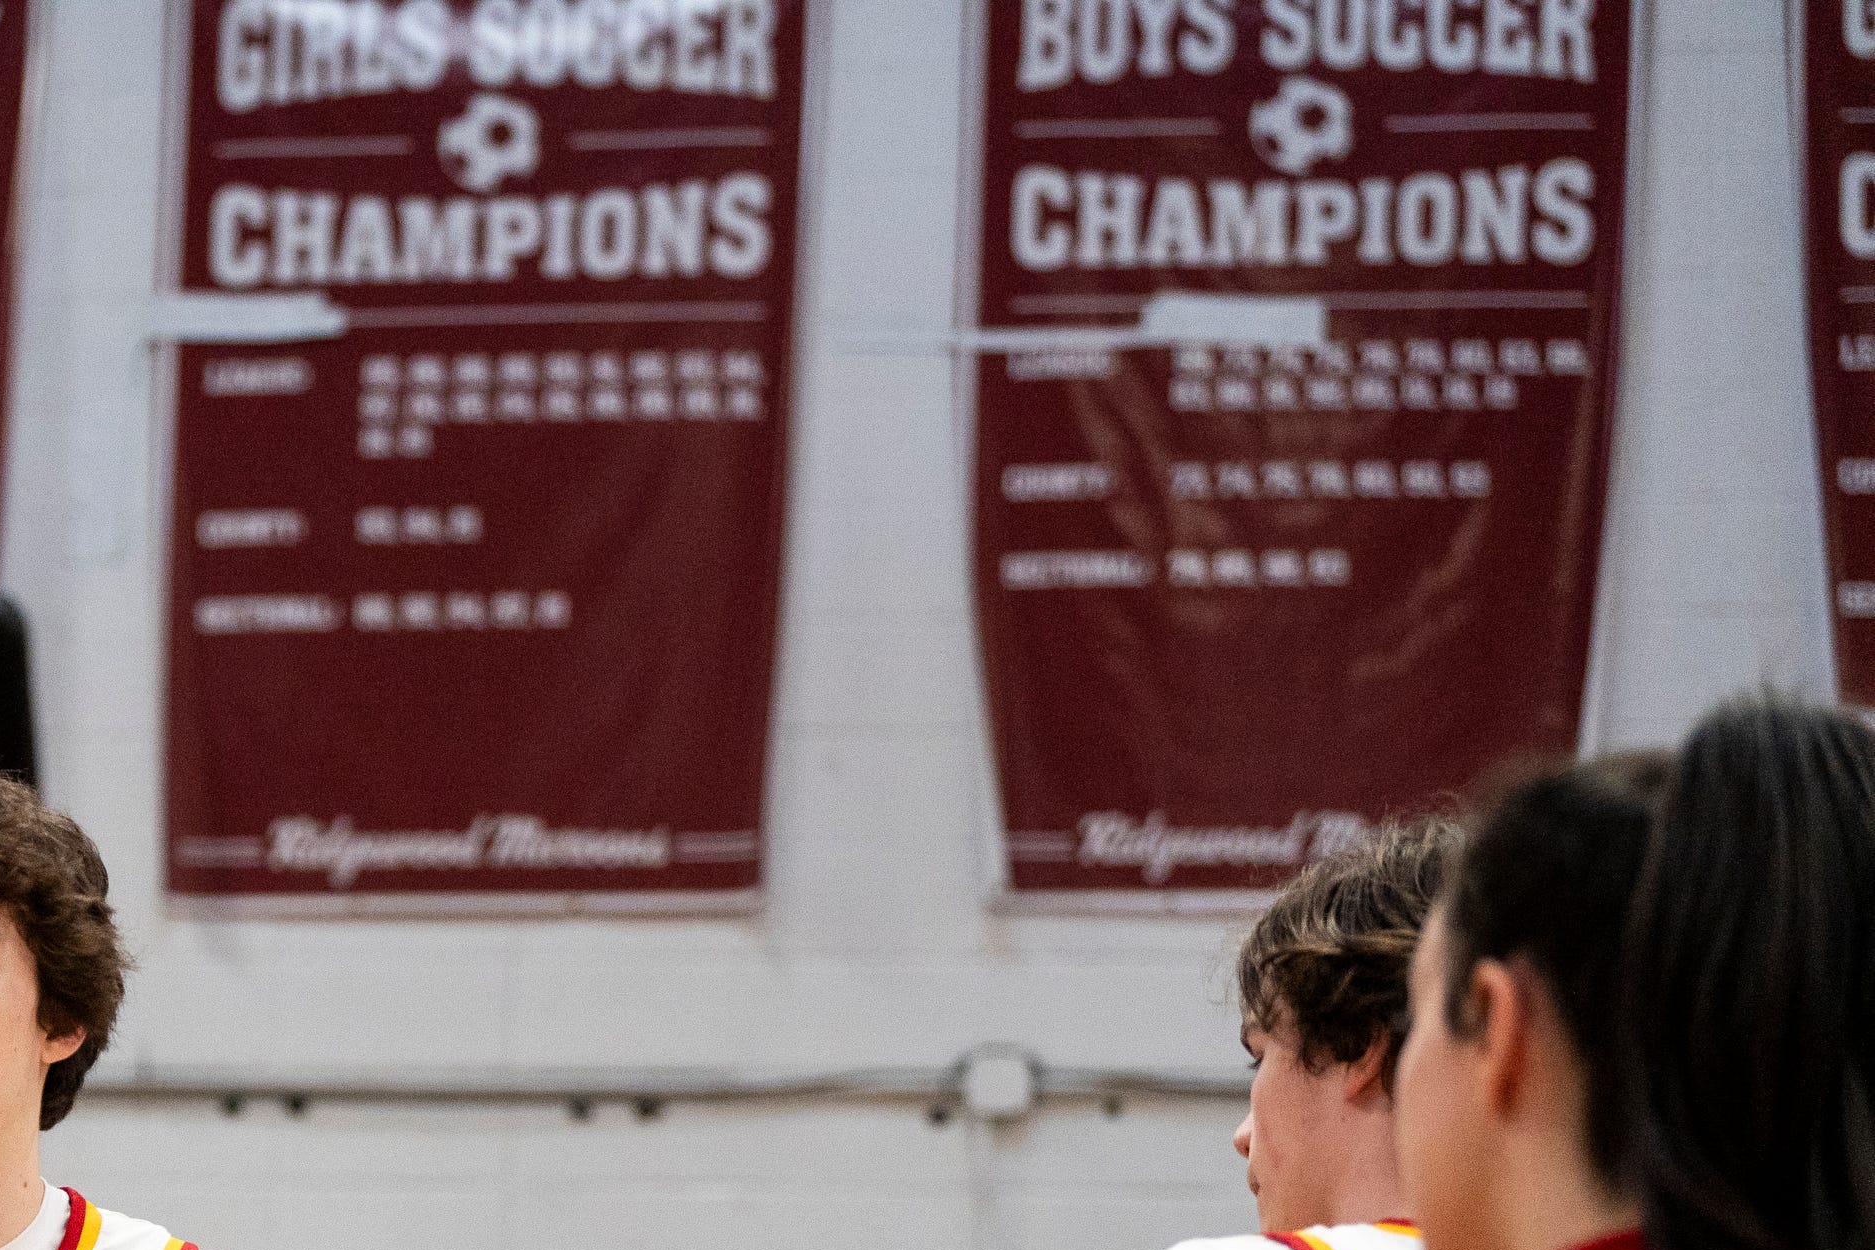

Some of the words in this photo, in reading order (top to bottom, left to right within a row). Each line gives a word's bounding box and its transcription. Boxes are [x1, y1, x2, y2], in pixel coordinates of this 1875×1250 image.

[219, 0, 447, 110] GIRLS
[466, 0, 777, 98] SOCCER
[1015, 0, 1235, 91] BOYS
[1259, 0, 1599, 84] SOCCER
[210, 173, 773, 286] CHAMPIONS
[1009, 156, 1596, 270] CHAMPIONS
